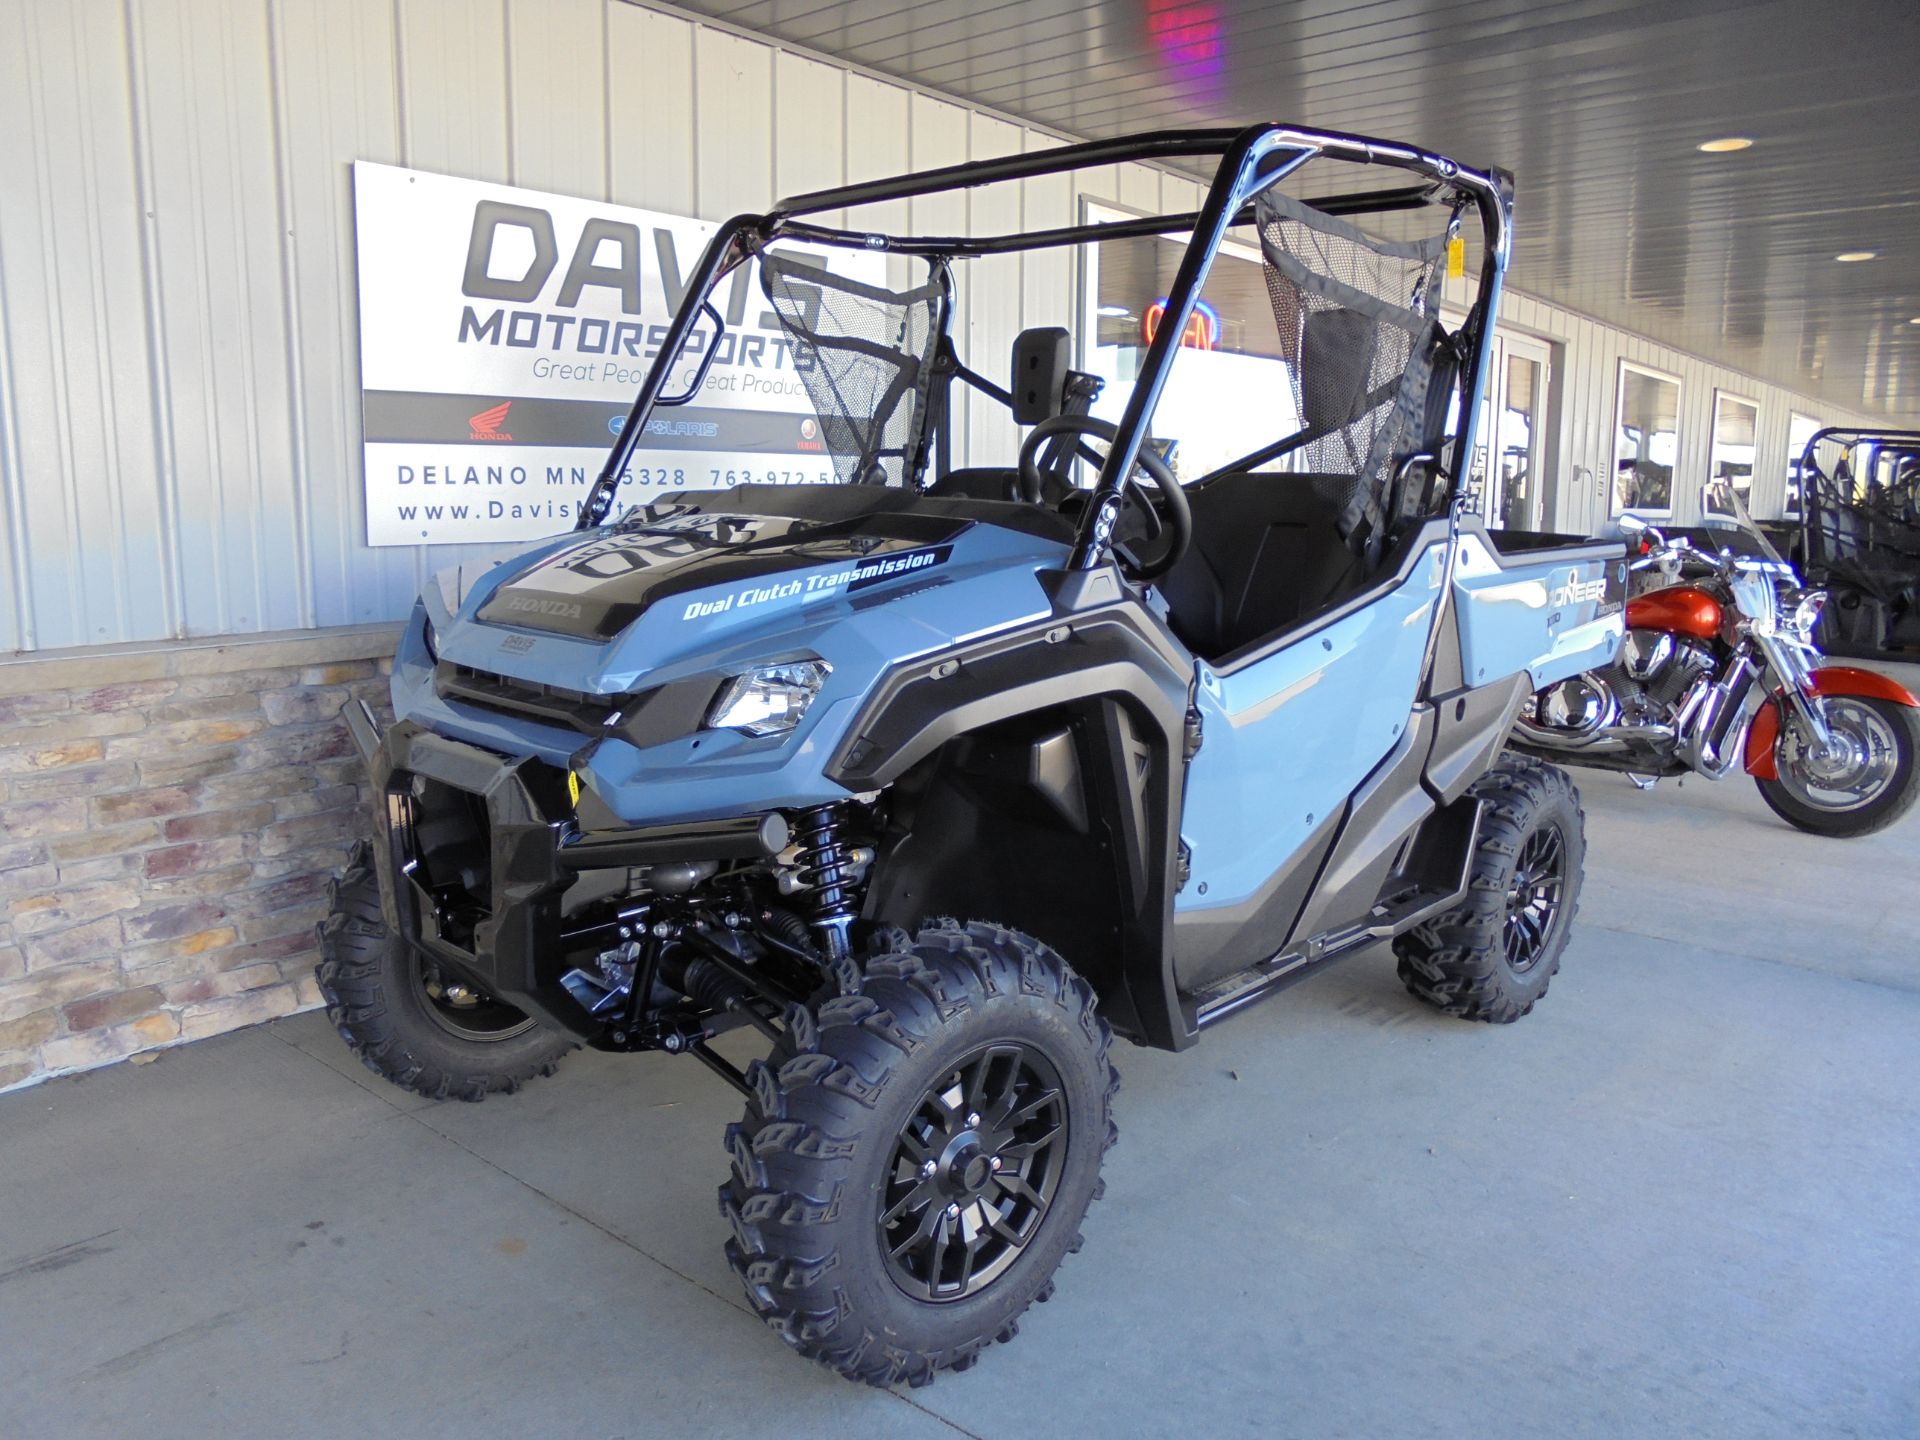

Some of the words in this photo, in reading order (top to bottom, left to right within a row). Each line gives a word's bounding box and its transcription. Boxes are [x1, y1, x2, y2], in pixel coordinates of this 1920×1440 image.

[461, 199, 828, 337] DAVIS
[532, 357, 596, 383] Great
[683, 369, 737, 391] Geat
[470, 432, 513, 441] HONDA
[644, 420, 719, 437] POLARIS
[797, 441, 822, 451] YAMAHA
[397, 465, 527, 485] DELANO
[546, 466, 585, 485] MN
[606, 468, 685, 486] 5328
[683, 592, 732, 621] Dual
[737, 576, 802, 608] Clutch
[806, 552, 936, 592] Transmission
[505, 597, 583, 619] HONDA
